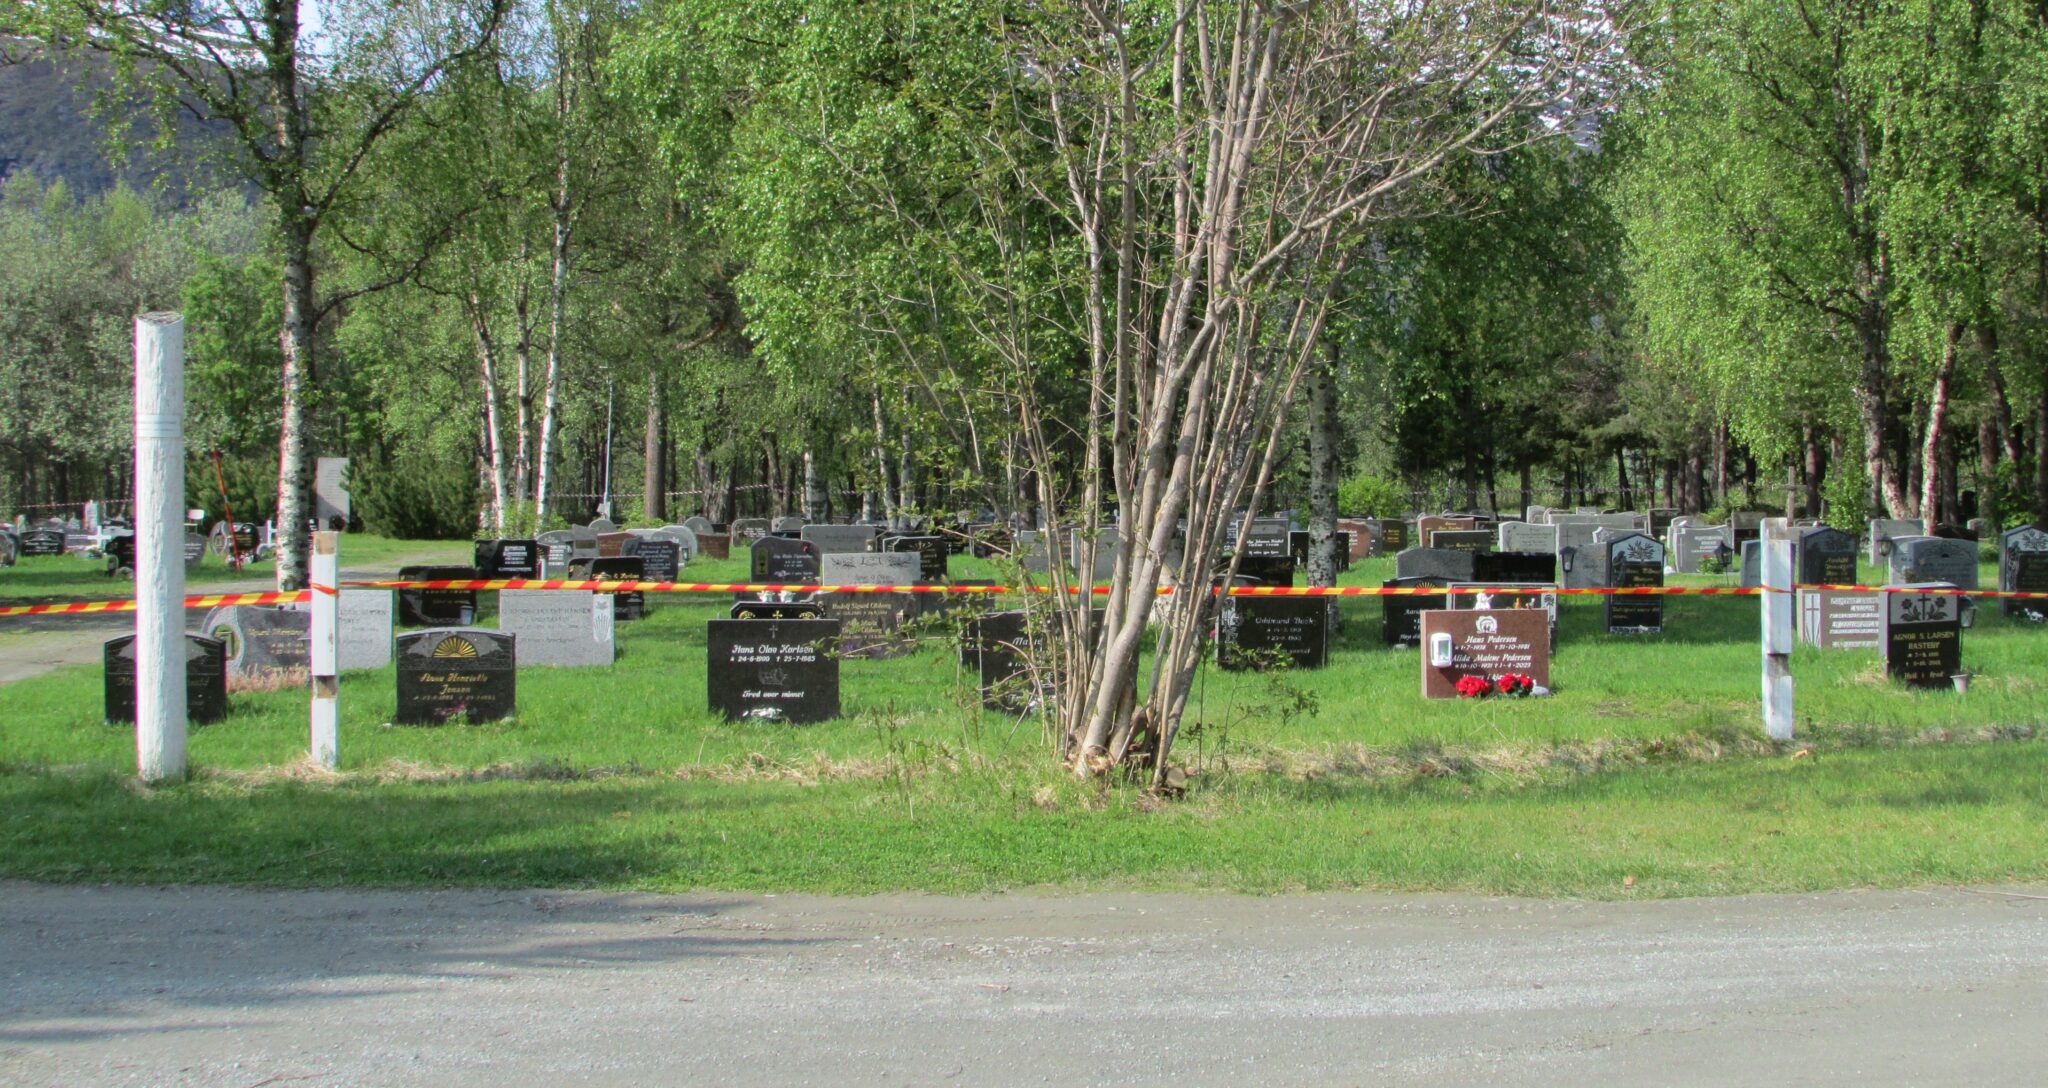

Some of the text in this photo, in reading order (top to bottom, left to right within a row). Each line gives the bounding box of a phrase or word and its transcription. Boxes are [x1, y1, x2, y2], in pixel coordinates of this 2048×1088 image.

[1465, 635, 1518, 644] Hans Pedersen
[732, 643, 814, 654] Hans Olav Karlsen
[1474, 653, 1501, 663] Malene
[1502, 652, 1533, 662] Pedersen
